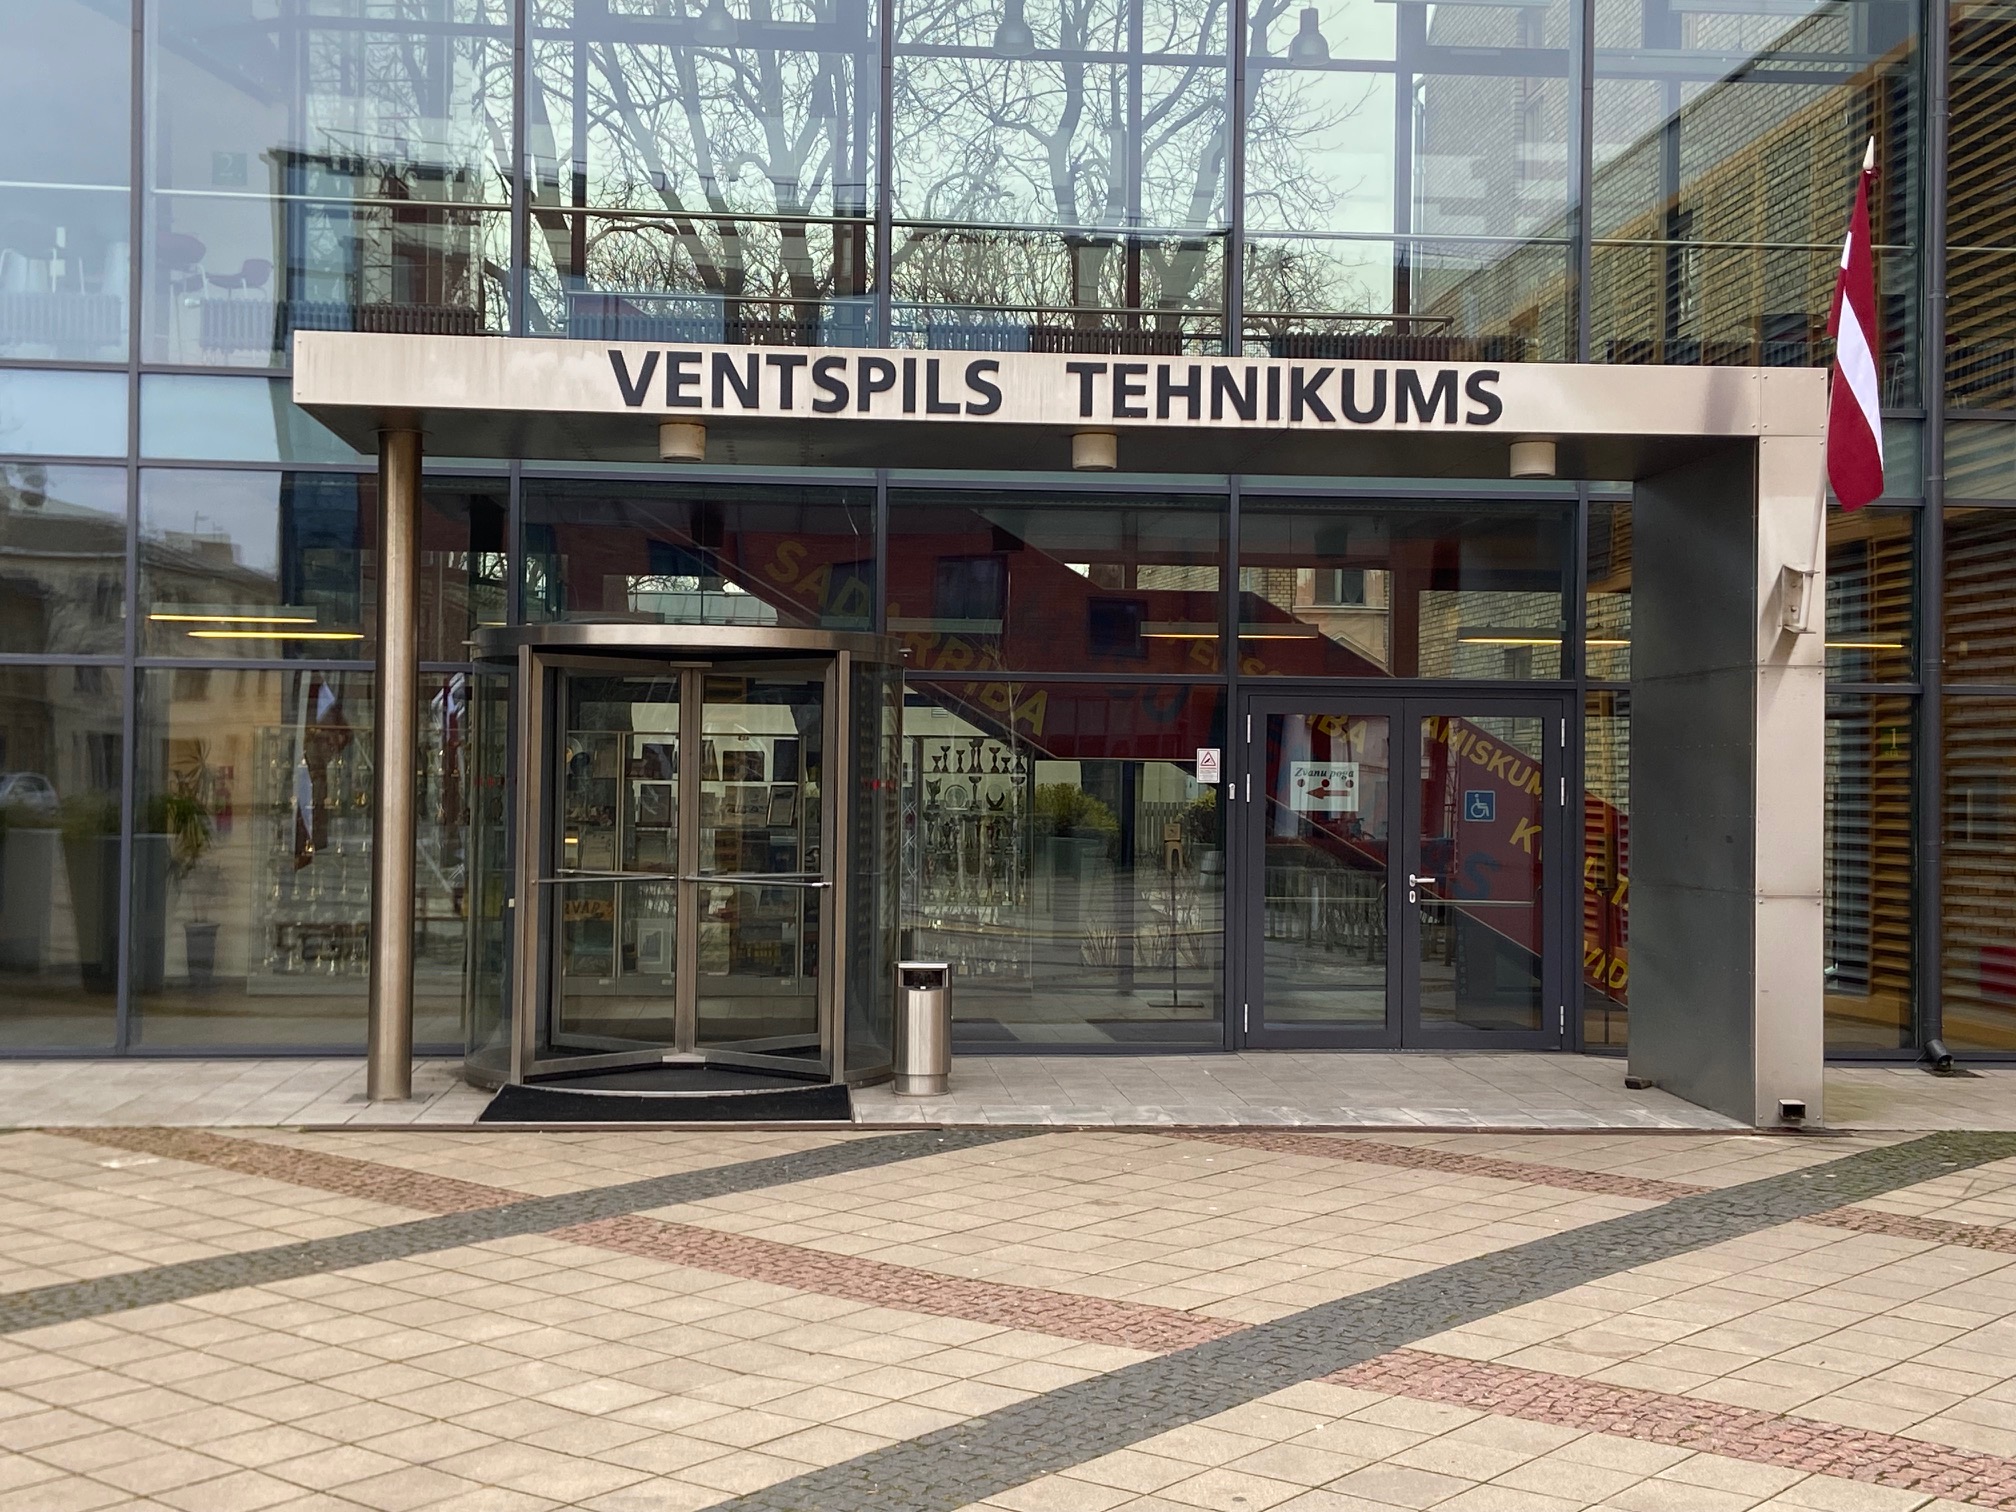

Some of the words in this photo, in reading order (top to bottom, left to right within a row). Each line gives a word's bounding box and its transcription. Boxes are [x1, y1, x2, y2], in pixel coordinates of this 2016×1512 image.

[608, 349, 1002, 415] VENTSPILS
[1066, 362, 1503, 426] TEHNIKUMS
[1294, 766, 1327, 777] Zvanu
[1329, 768, 1354, 780] poga
